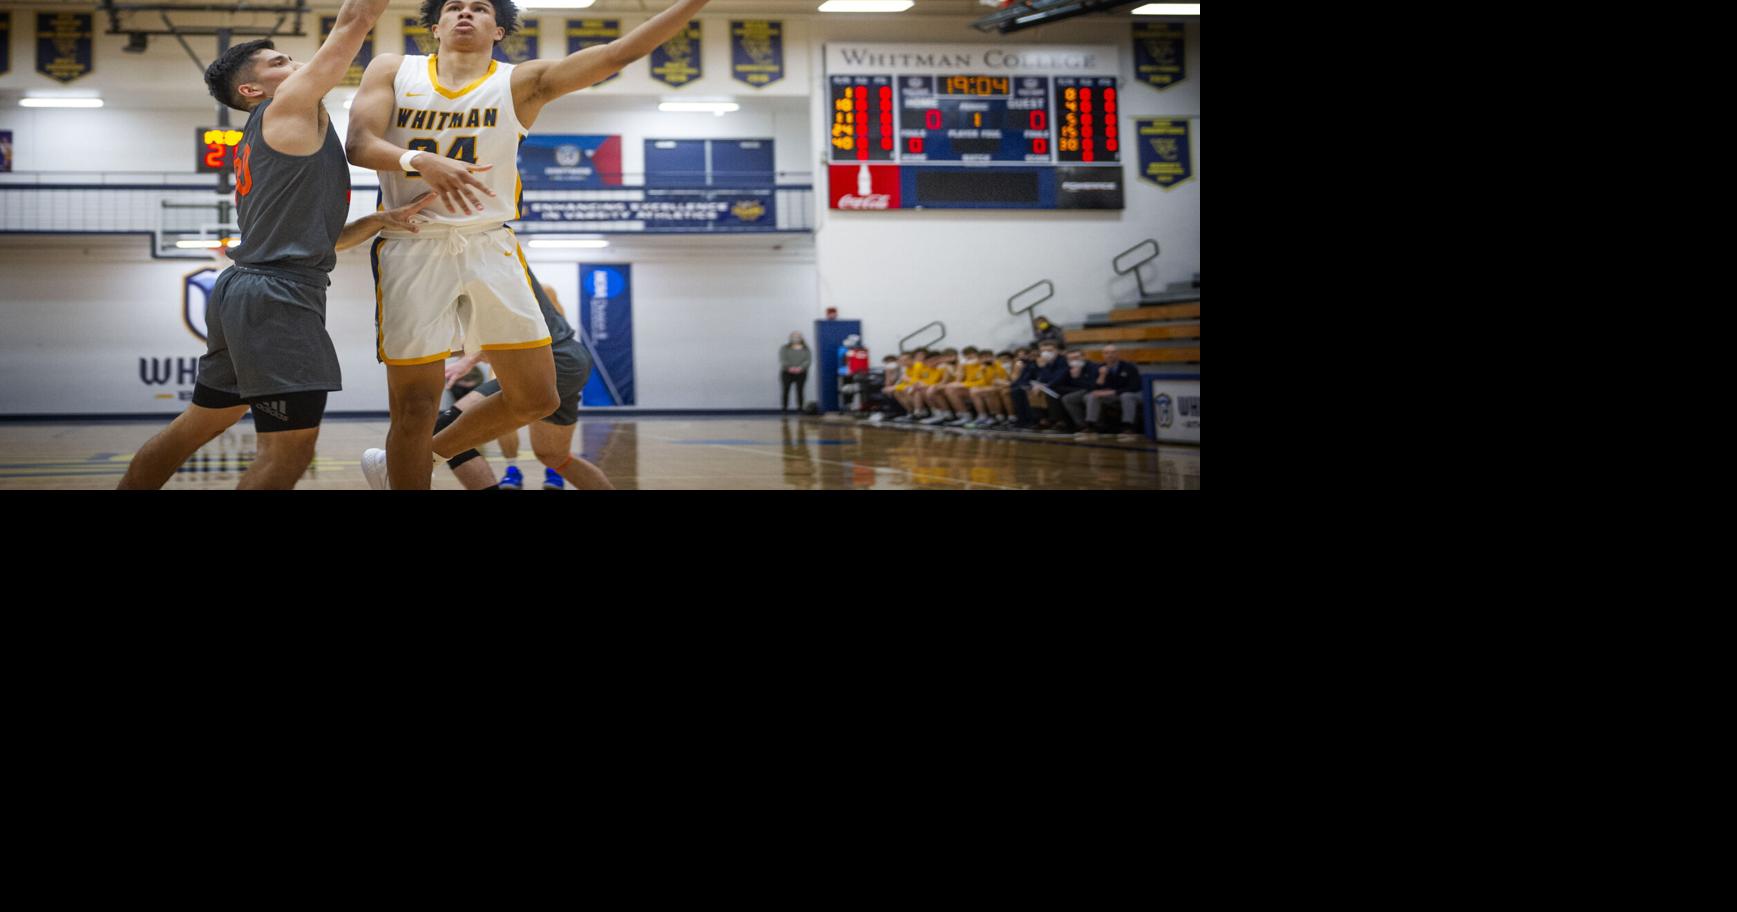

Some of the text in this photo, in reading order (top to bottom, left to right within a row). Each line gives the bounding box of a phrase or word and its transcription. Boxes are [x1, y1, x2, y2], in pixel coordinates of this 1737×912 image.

[841, 48, 1097, 68] WHITMAN COLLEGE
[947, 75, 1009, 96] 19:04
[1006, 98, 1043, 109] GUEST
[397, 107, 498, 131] WHITMAN
[925, 108, 942, 130] 0
[974, 112, 982, 128] 1
[1029, 109, 1046, 131] 0
[531, 203, 625, 212] ENHANCING
[630, 202, 728, 212] EXCELLENCE
